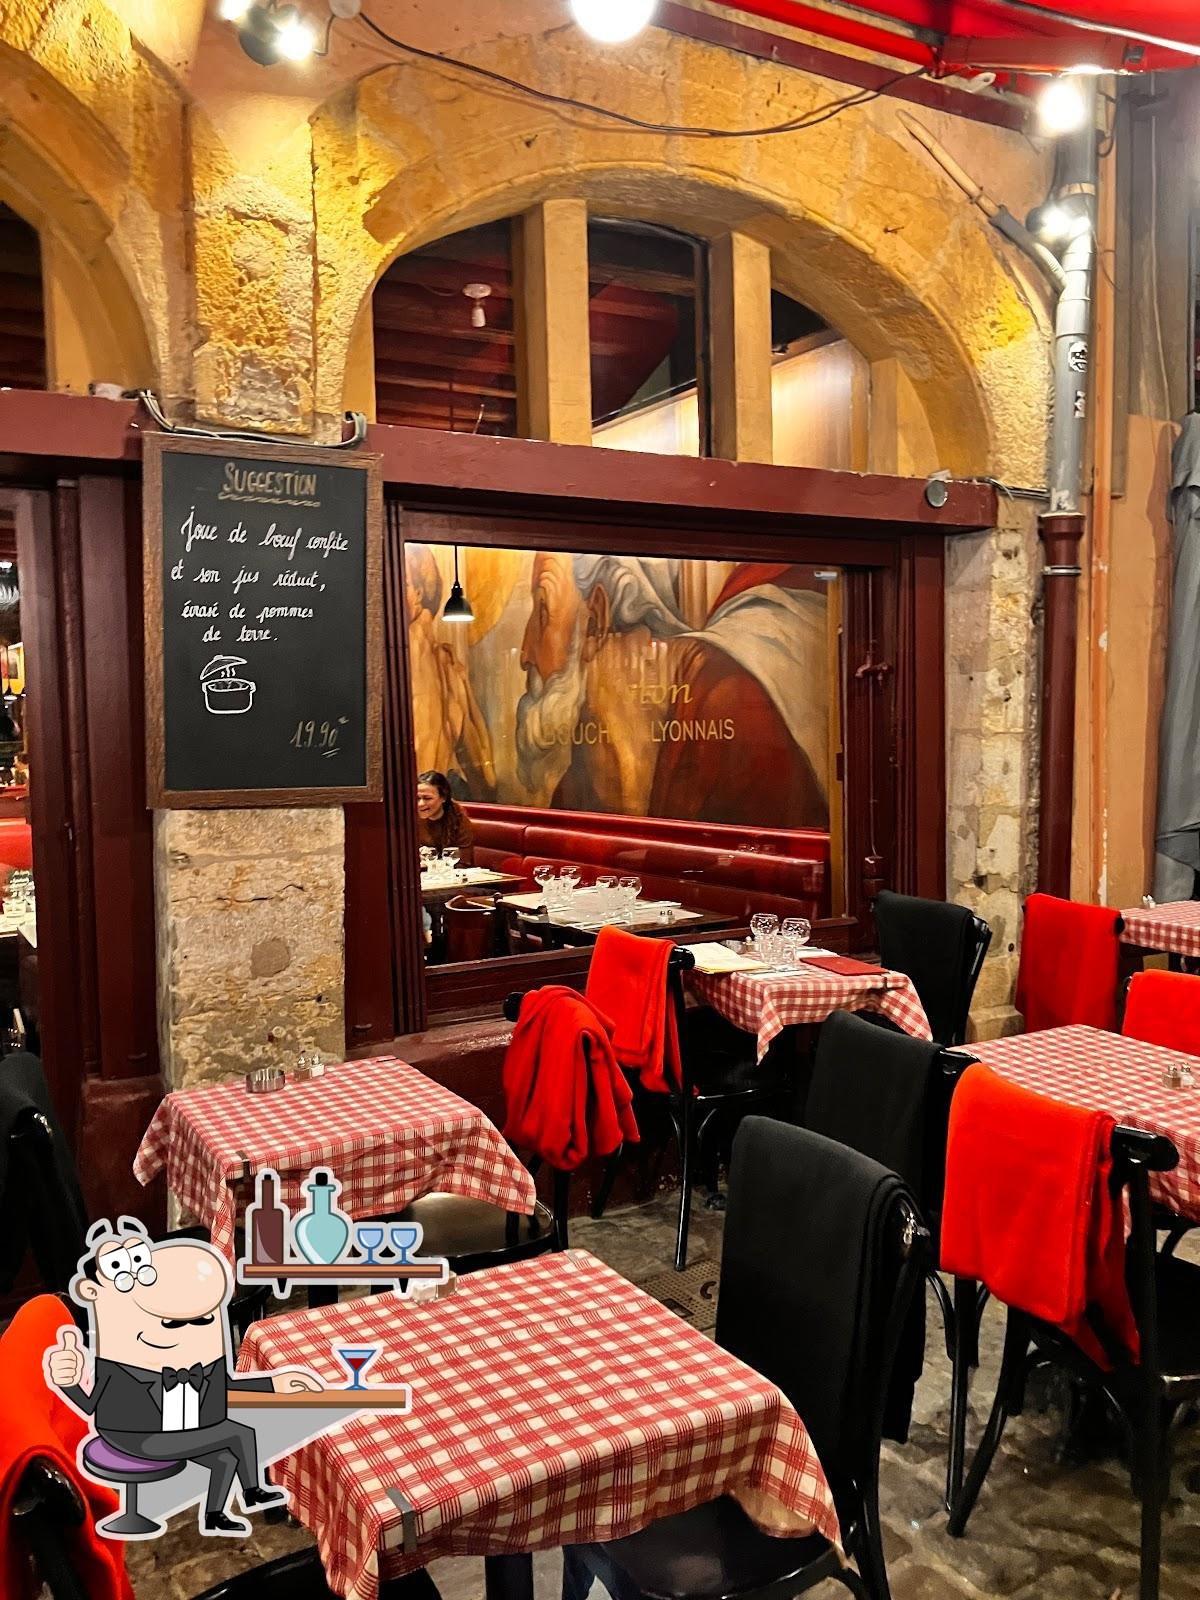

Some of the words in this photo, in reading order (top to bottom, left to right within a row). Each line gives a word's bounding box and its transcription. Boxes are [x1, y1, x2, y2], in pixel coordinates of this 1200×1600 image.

[227, 521, 247, 544] de
[305, 530, 349, 559] confite
[170, 558, 184, 580] et
[193, 567, 221, 583] son
[232, 565, 260, 594] jus
[228, 602, 246, 619] de
[256, 605, 314, 624] pommes
[202, 625, 222, 643] de
[650, 717, 736, 743] LYONNAIS
